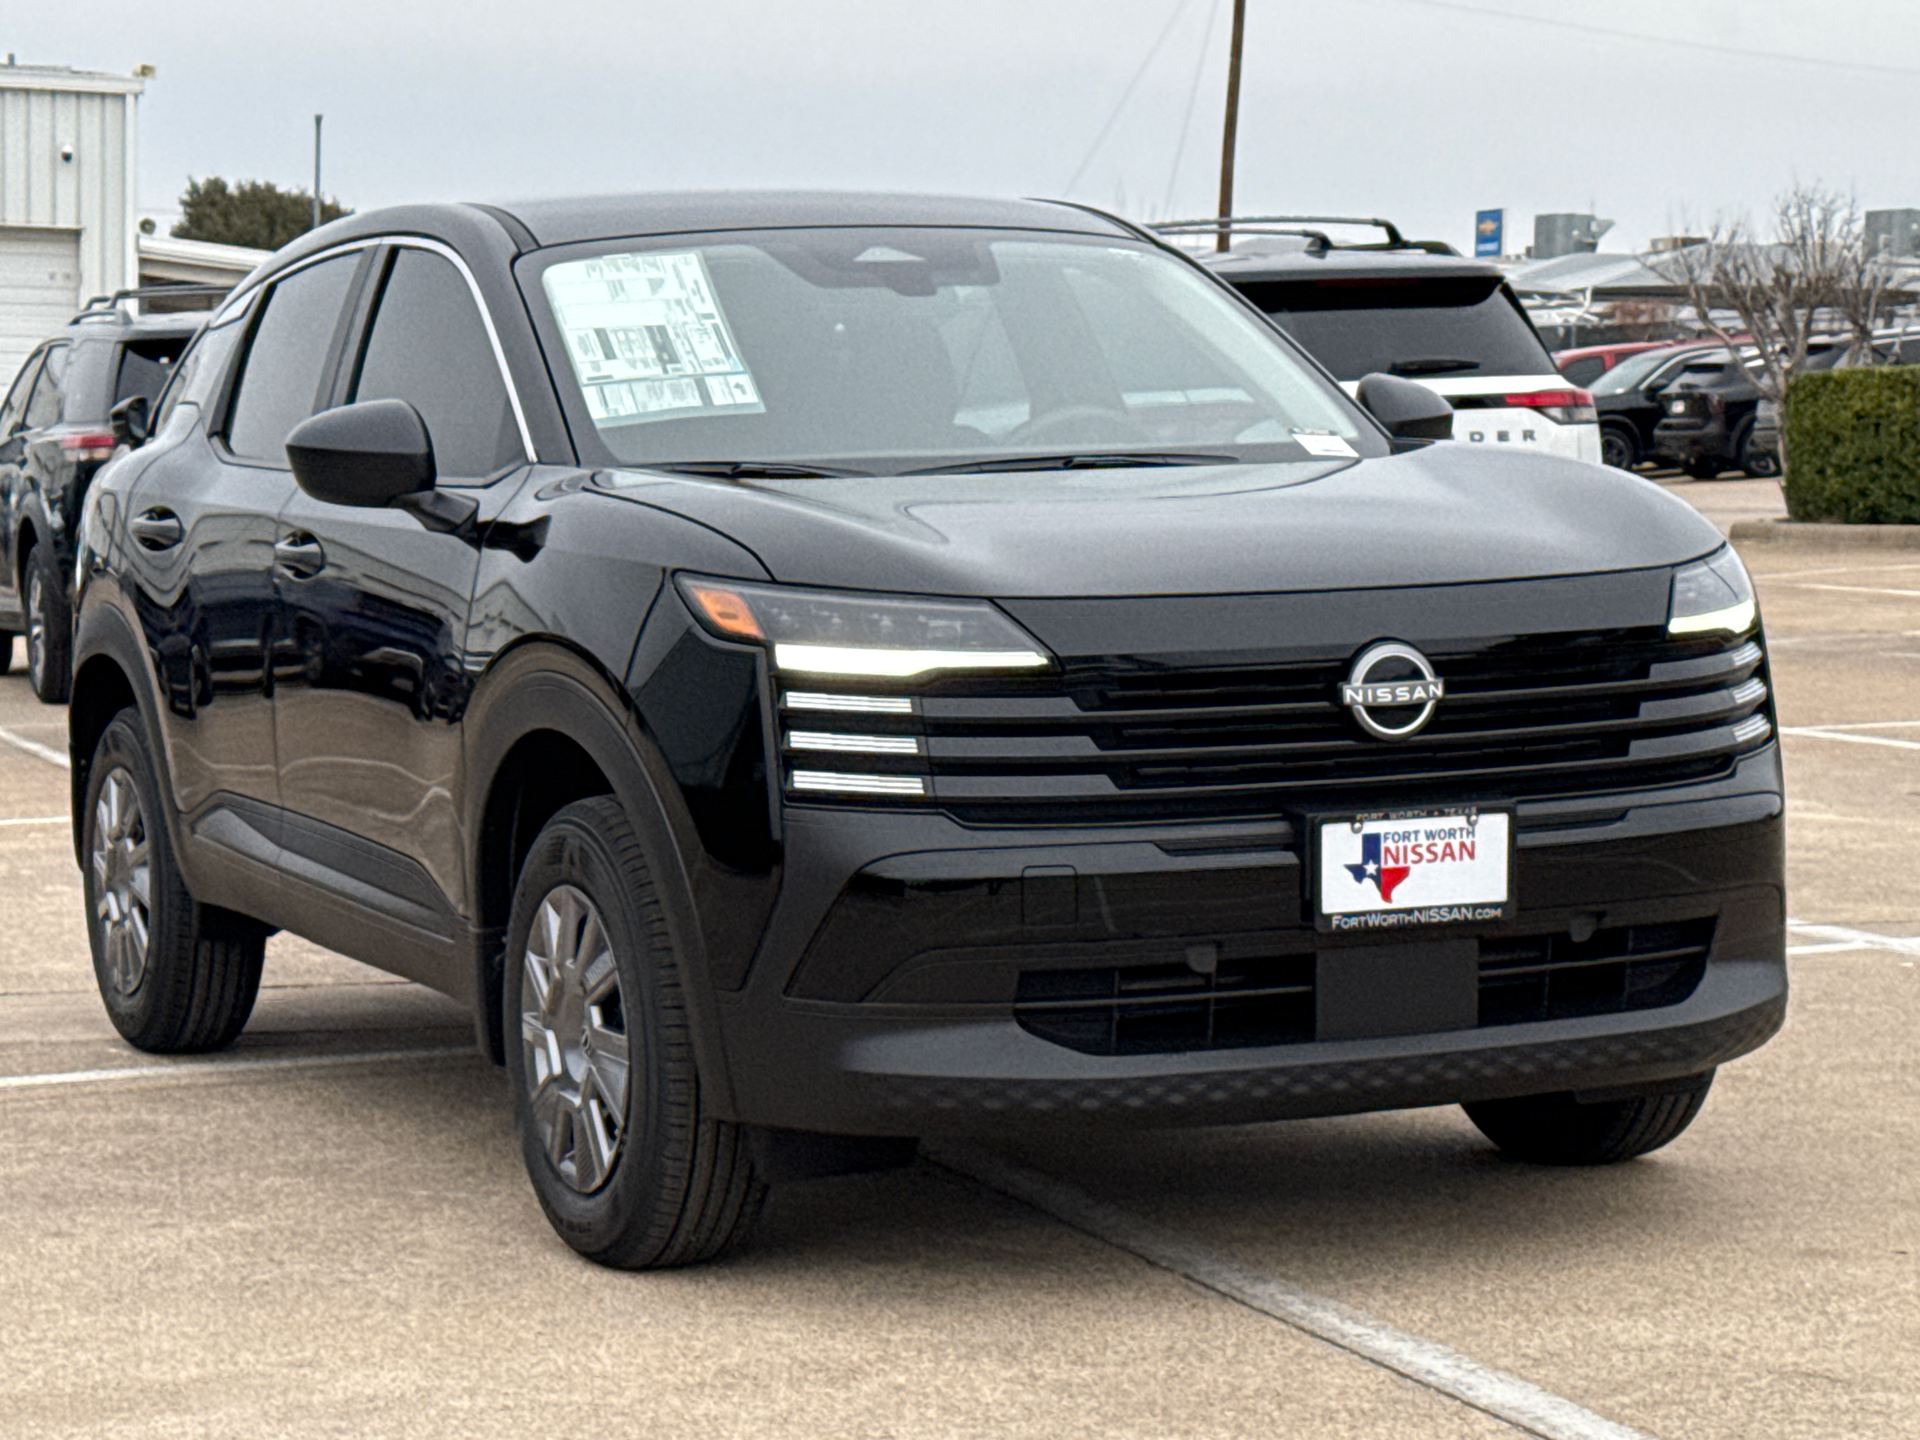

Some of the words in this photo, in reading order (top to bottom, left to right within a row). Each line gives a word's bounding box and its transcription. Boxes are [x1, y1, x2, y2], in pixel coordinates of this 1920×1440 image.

[1452, 429, 1537, 443] DER
[1345, 682, 1443, 704] NISSAN
[1383, 829, 1421, 844] FORT
[1424, 826, 1475, 842] WORTH
[1383, 840, 1476, 866] NISSAN
